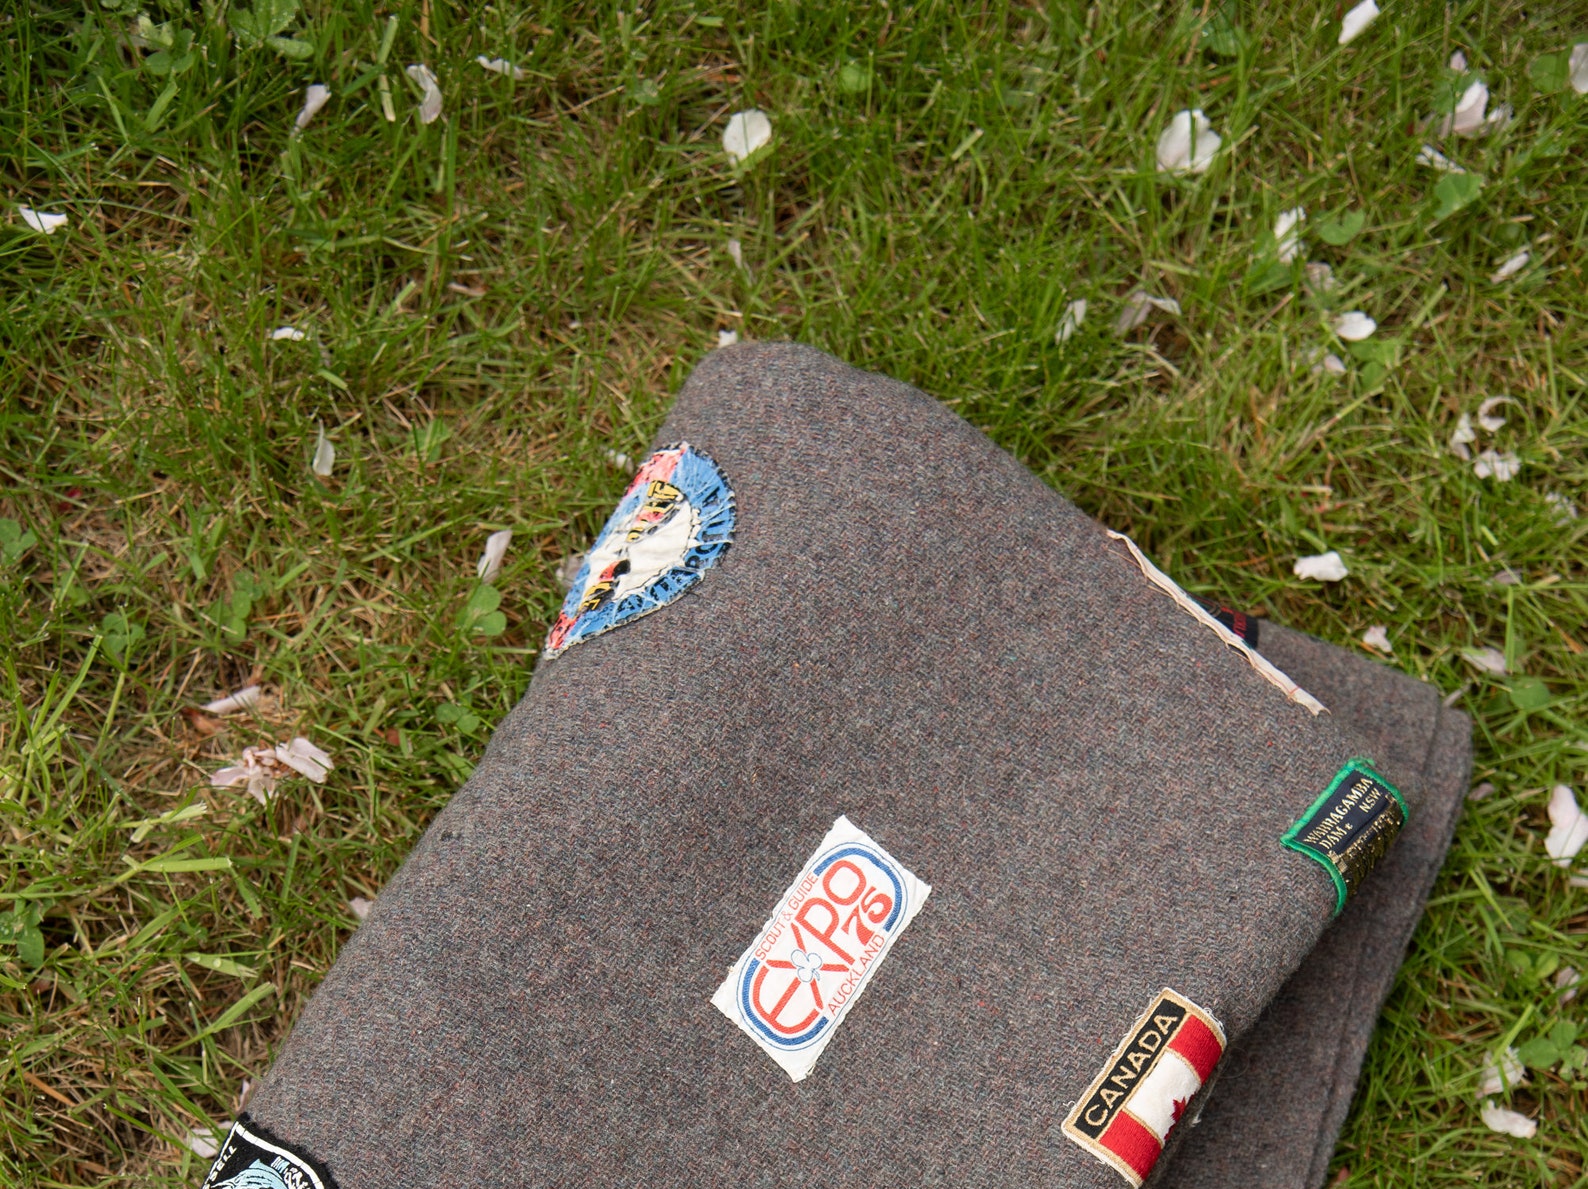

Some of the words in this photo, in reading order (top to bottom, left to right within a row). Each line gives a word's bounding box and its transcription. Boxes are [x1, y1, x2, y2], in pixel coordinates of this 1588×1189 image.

[616, 486, 726, 615] ANTARCTIA
[1303, 777, 1374, 844] WARRAGAMBA
[1318, 826, 1348, 850] DAM
[752, 859, 867, 1035] EXPO
[755, 921, 787, 961] SCOUT
[780, 909, 793, 923] &
[790, 871, 819, 911] GUIDE
[842, 886, 893, 947] 75
[828, 934, 886, 1017] AUCKLAND
[1084, 1014, 1178, 1127] CANADA
